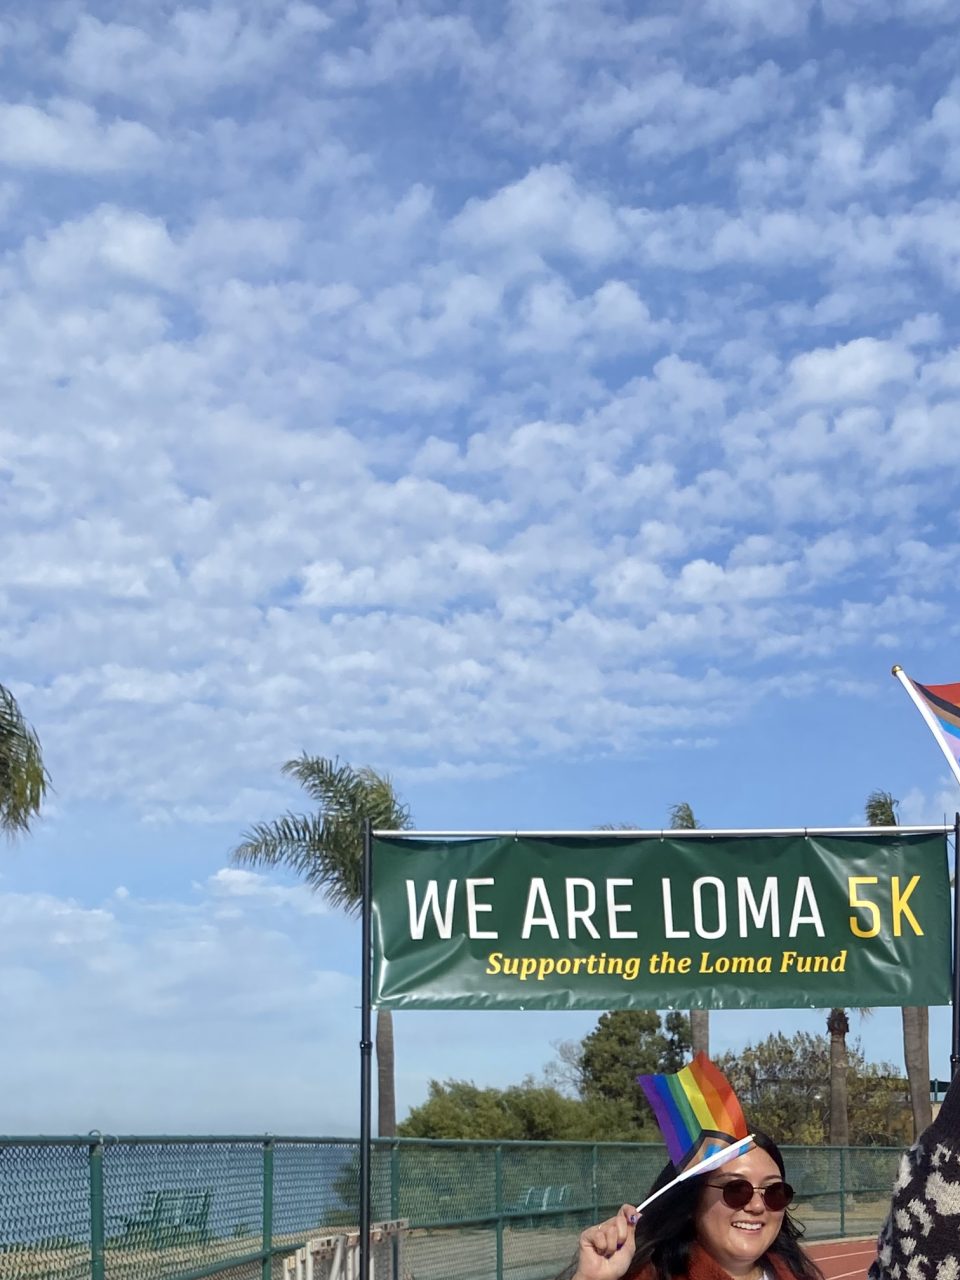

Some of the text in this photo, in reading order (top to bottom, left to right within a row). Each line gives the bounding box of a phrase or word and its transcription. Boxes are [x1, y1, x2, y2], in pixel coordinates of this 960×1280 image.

[405, 875, 925, 940] WE ARE LOMA 5K
[486, 950, 848, 981] Supporting the Loma Fund
